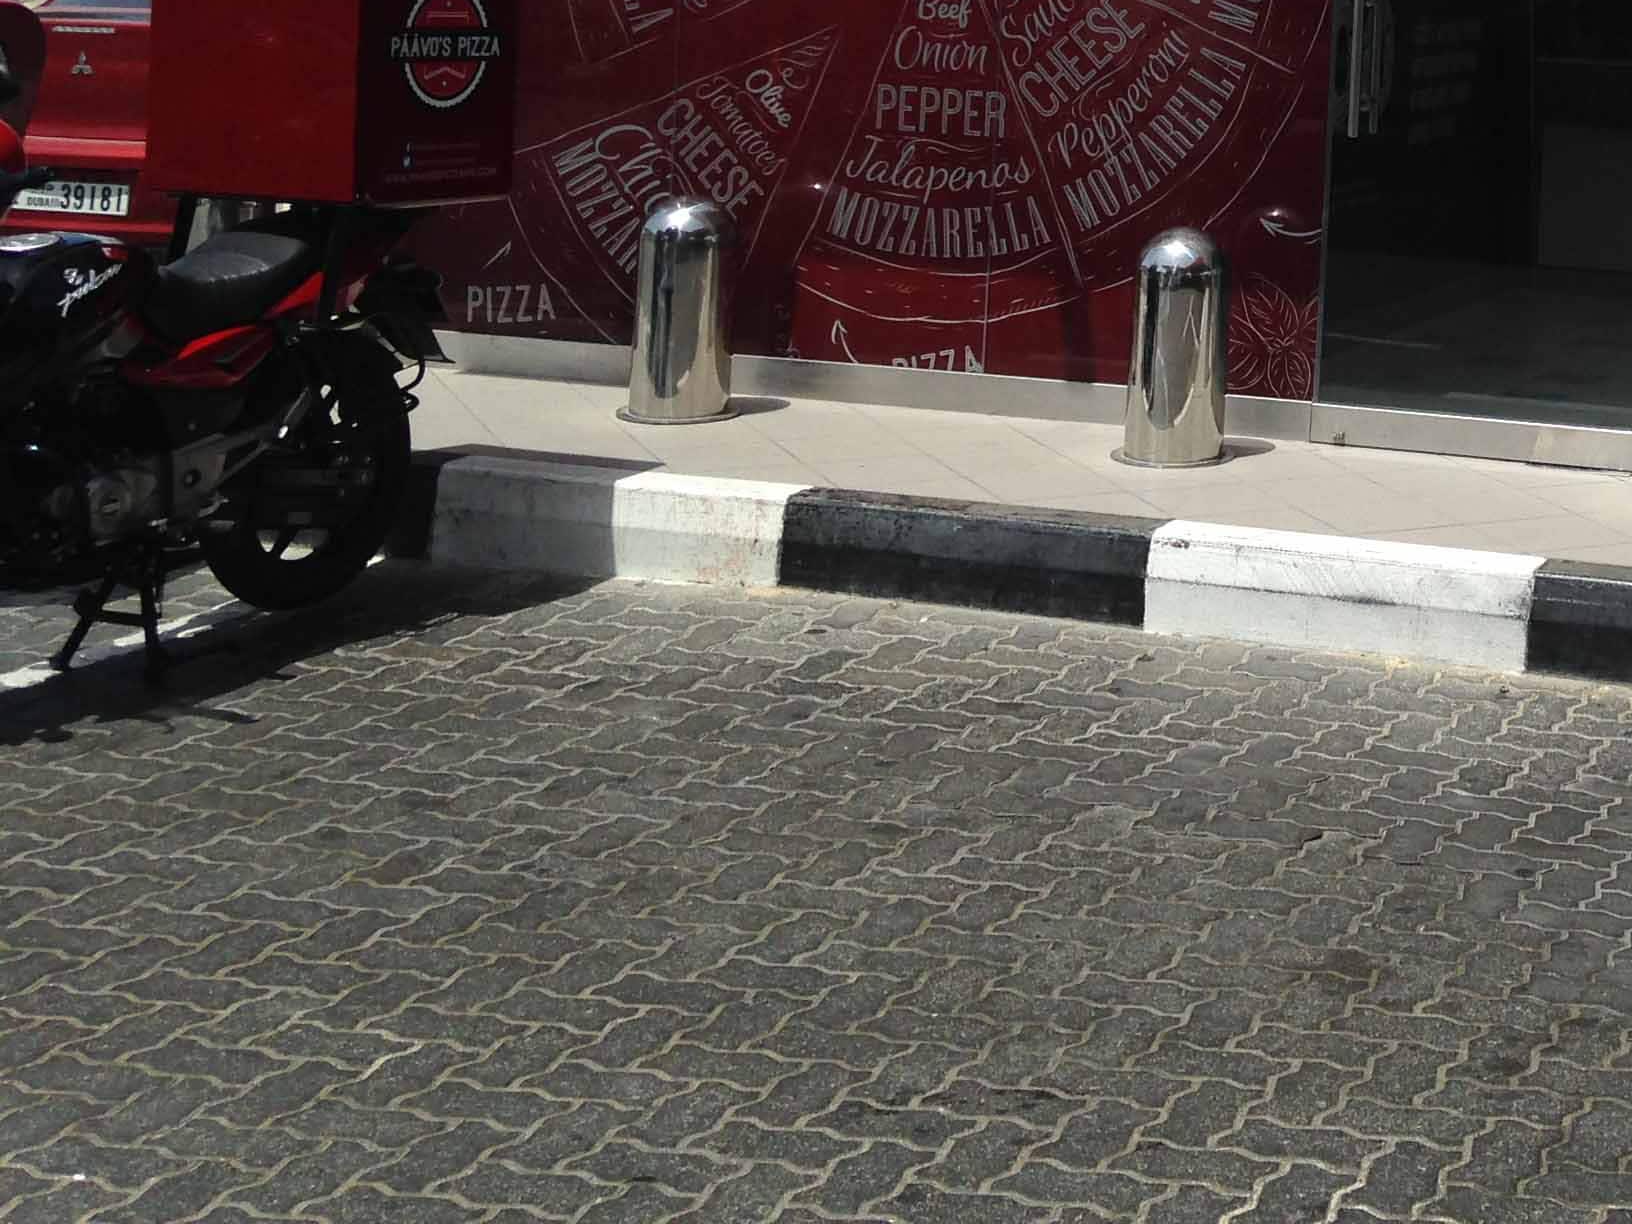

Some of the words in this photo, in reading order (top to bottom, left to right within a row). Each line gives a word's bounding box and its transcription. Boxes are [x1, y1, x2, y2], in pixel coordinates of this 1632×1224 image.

[457, 35, 500, 57] PIZZA
[894, 26, 988, 75] Onion
[745, 68, 793, 128] Olive
[876, 84, 1007, 138] PEPPER
[1048, 22, 1191, 169] Pepperoni
[657, 98, 766, 223] CHEESE
[1064, 48, 1247, 232] MOZZARELLA
[60, 182, 123, 213] 39181
[827, 187, 1052, 259] MOZZARELLA
[466, 283, 557, 324] PIZZA
